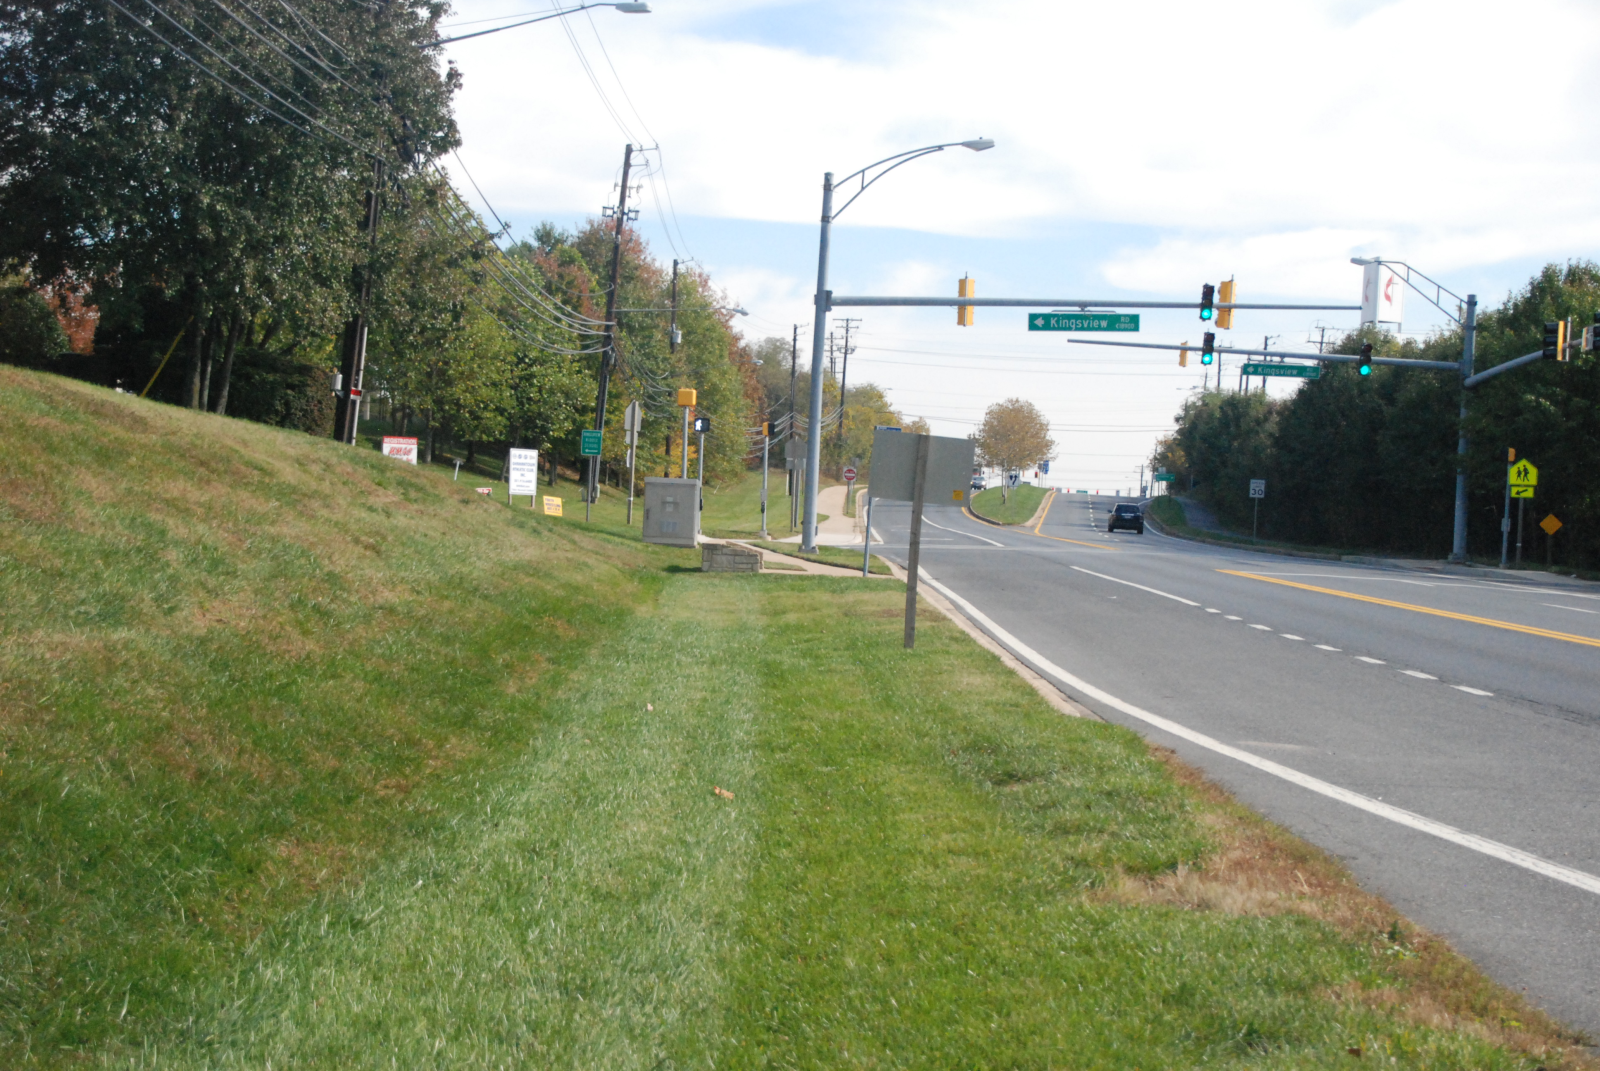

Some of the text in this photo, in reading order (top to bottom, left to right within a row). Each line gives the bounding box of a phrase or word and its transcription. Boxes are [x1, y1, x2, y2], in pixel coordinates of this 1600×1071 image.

[1050, 317, 1109, 331] Kingsview
[1257, 366, 1298, 376] Kingsview
[384, 437, 417, 445] REGISTRATION
[1251, 488, 1264, 496] 30
